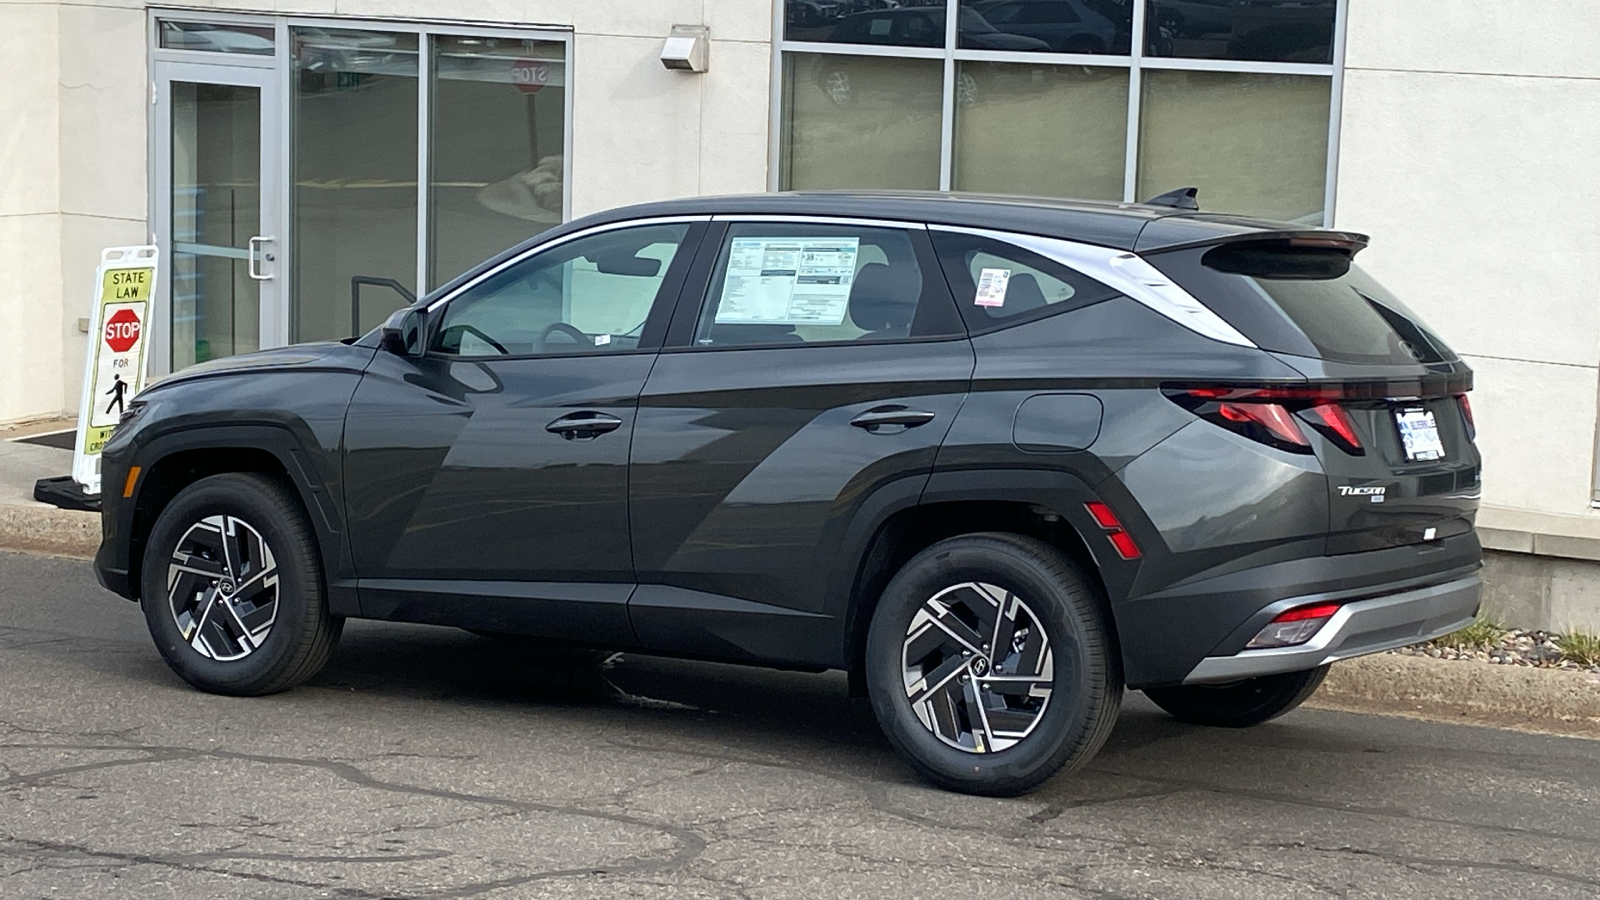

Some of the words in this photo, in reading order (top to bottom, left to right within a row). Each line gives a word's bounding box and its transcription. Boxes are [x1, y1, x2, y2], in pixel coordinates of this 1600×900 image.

[113, 272, 145, 284] STATE
[116, 286, 139, 298] LAW
[106, 322, 140, 339] STOP
[113, 358, 129, 368] FOR
